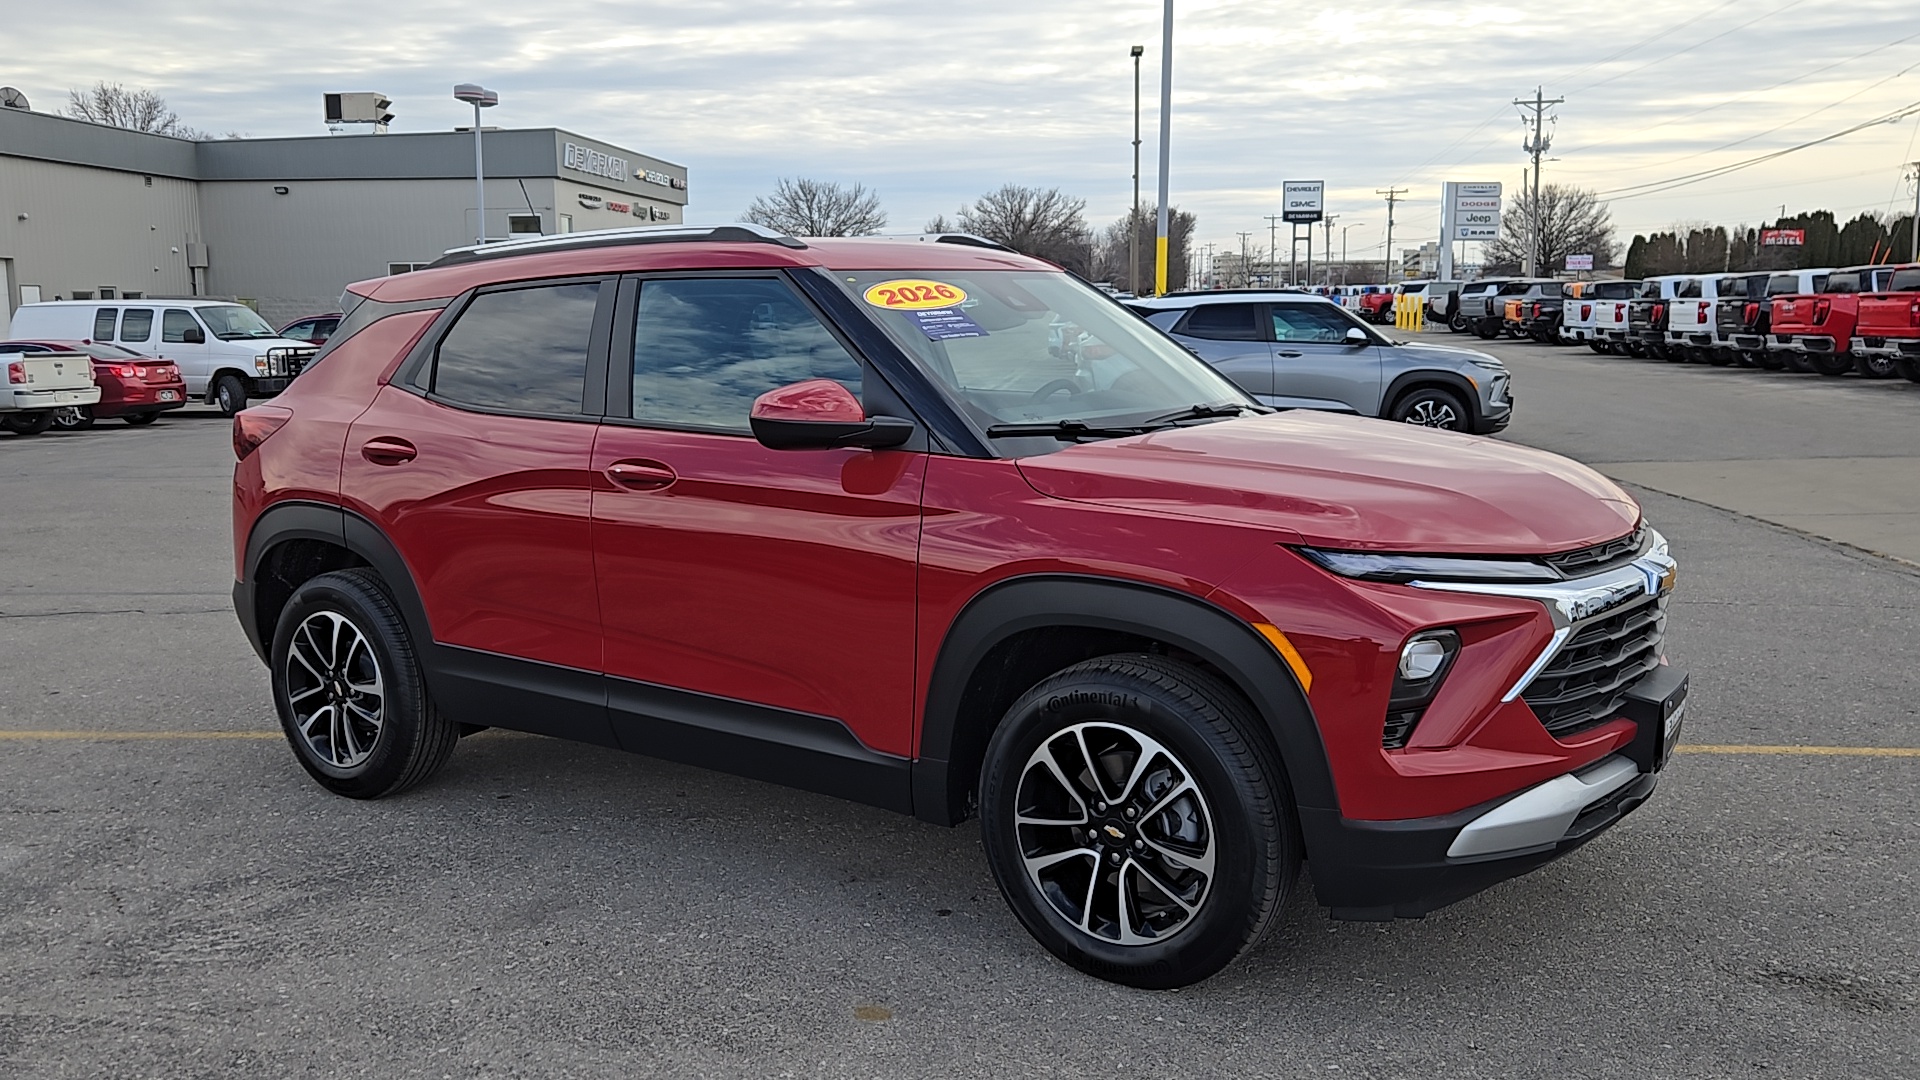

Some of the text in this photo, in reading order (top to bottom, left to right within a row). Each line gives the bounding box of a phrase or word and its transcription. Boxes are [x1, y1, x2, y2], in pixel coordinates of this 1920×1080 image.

[564, 142, 628, 181] DEYARMAN
[1290, 200, 1316, 208] GMC
[1466, 213, 1491, 224] Jeep
[1765, 236, 1803, 245] MOTEL
[878, 284, 956, 306] 2026
[1049, 689, 1129, 712] Continental
